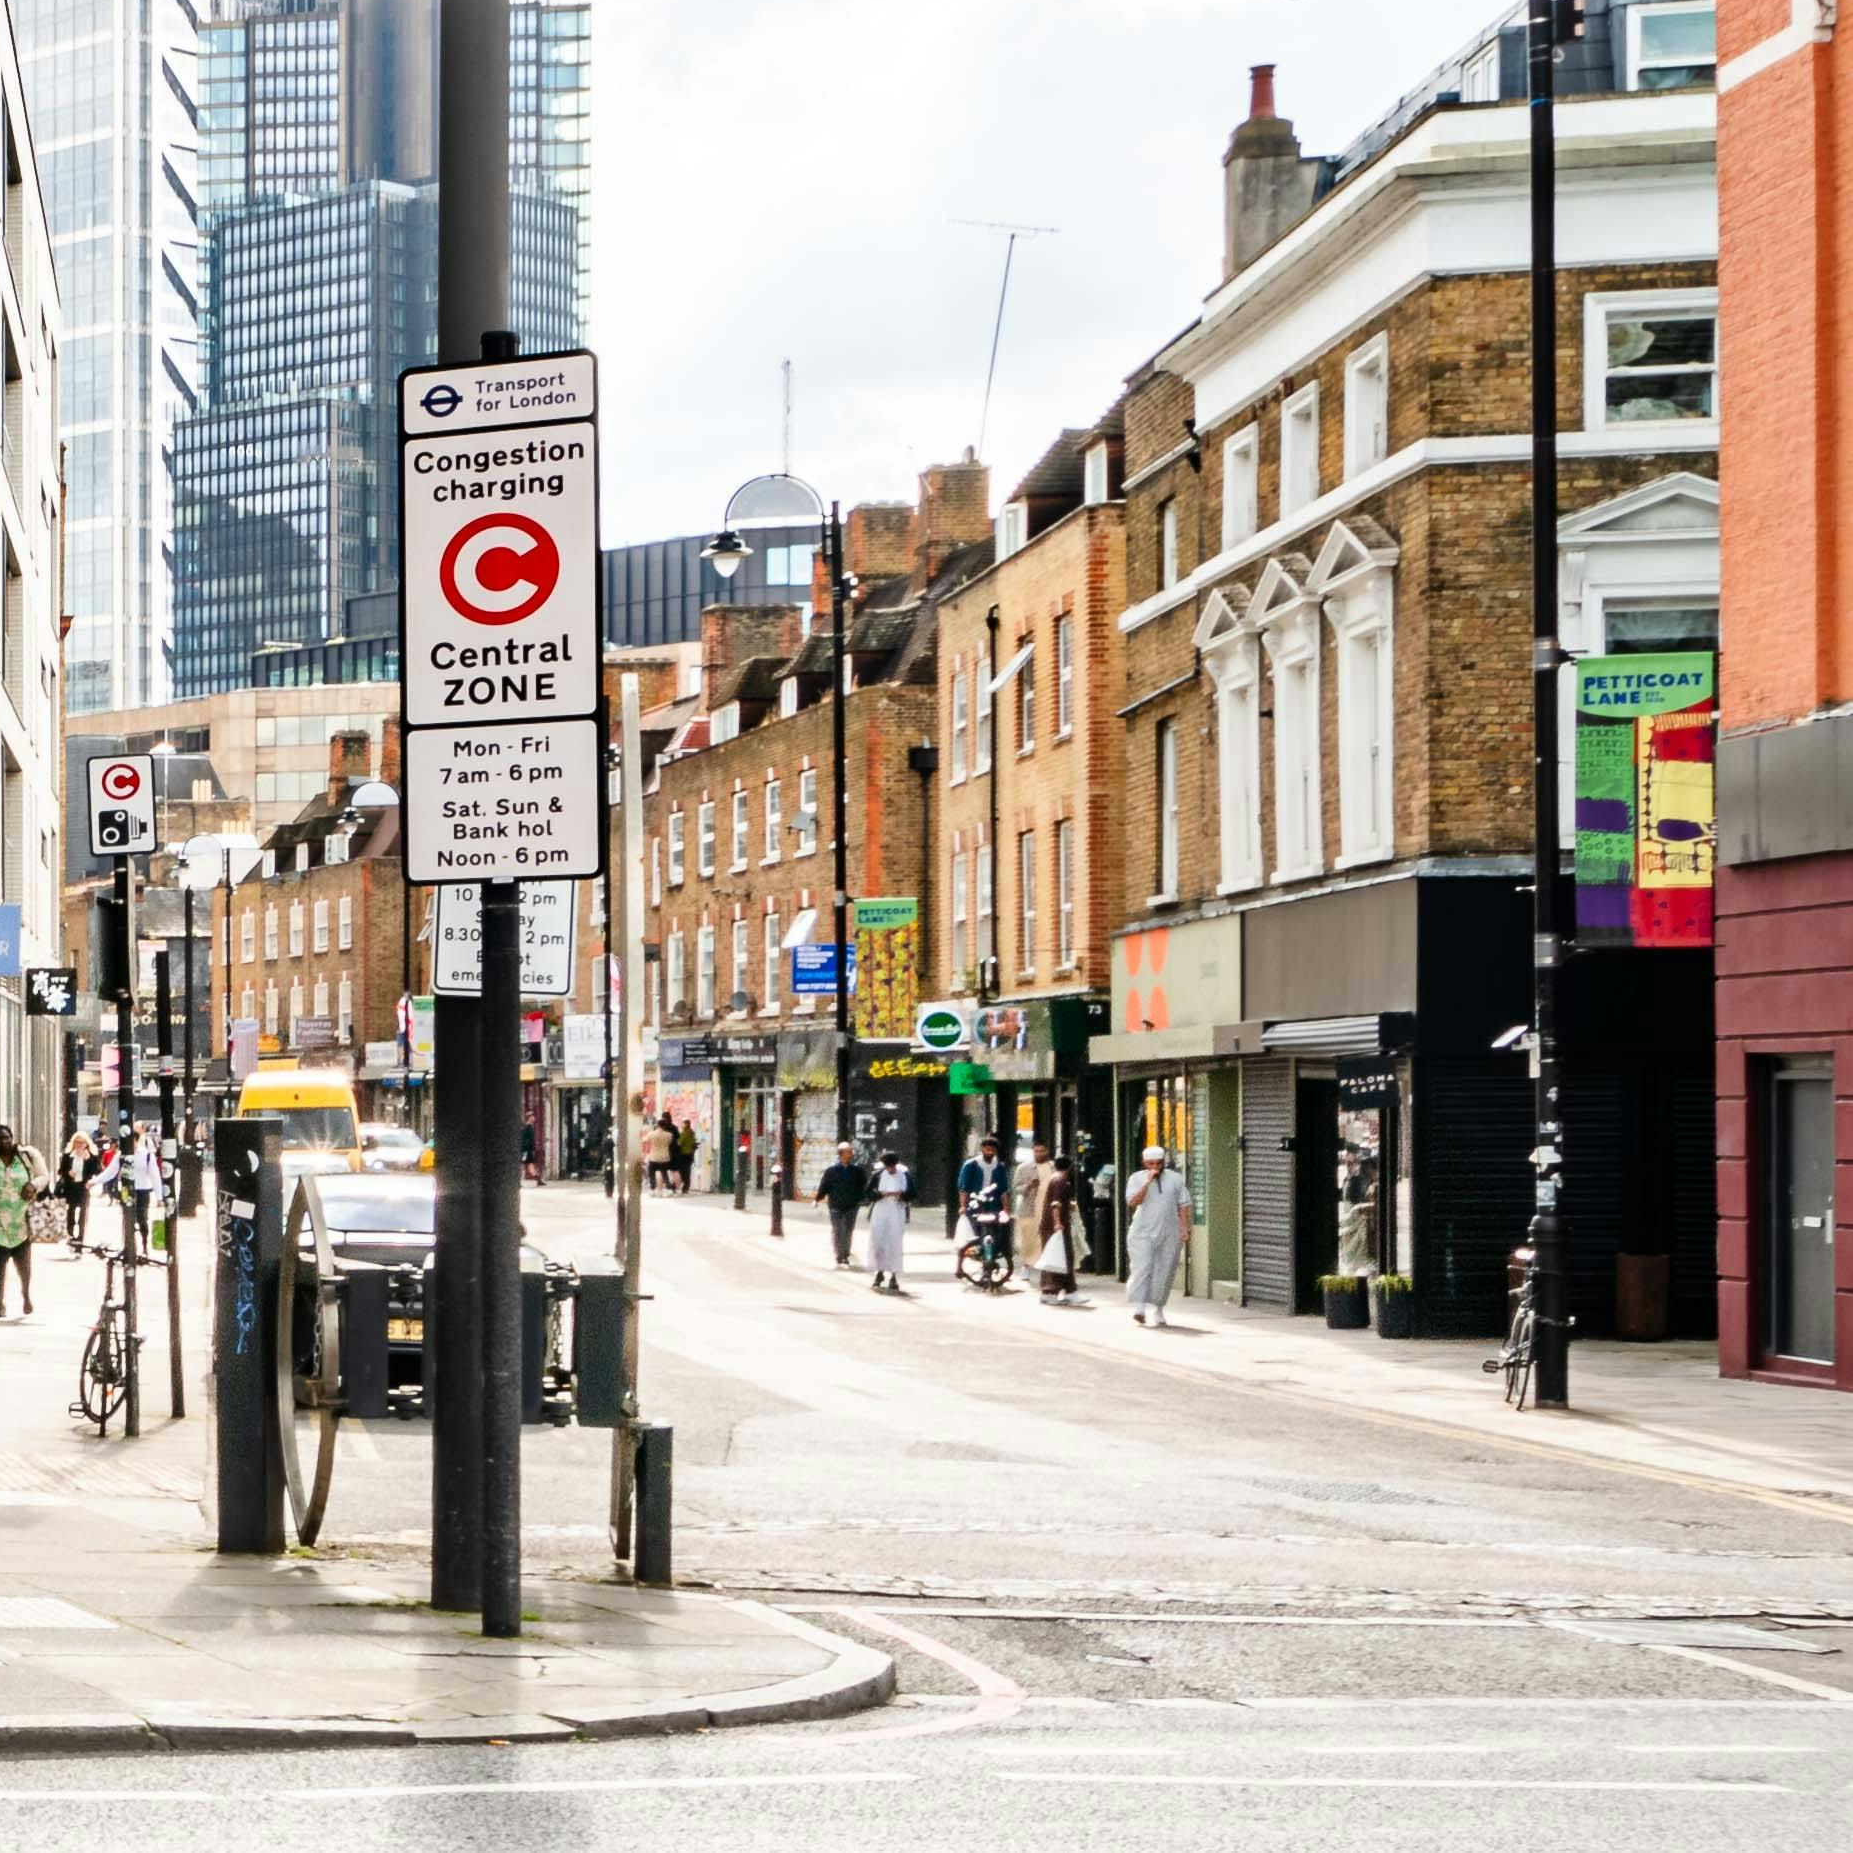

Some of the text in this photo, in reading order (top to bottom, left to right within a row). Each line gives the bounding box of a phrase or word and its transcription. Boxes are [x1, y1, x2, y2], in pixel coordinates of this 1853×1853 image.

[475, 372, 565, 394] Transport
[476, 390, 576, 412] for London
[413, 440, 585, 474] Congestion
[433, 473, 564, 503] charging
[430, 633, 572, 670] Central
[443, 672, 557, 707] ZONE
[1583, 673, 1704, 690] PETTICOAT
[1583, 691, 1641, 706] LANE
[453, 740, 501, 758] Mon
[521, 736, 550, 754] Fri
[439, 768, 452, 785] 7
[457, 769, 489, 784] am
[509, 764, 523, 781] 6
[529, 766, 563, 783] pm
[442, 796, 563, 818] Sat. Sun &
[453, 819, 553, 840] Bank hol
[437, 850, 495, 867] Noon
[515, 847, 529, 864] 6
[535, 849, 569, 866] pm
[455, 888, 473, 902] 10
[532, 893, 557, 906] pm
[858, 907, 913, 915] PETTICOAT
[858, 916, 884, 924] LANE
[444, 927, 565, 946] 8.30 2 pm
[451, 971, 554, 985] emecies
[1088, 1005, 1102, 1015] 73
[1339, 1074, 1395, 1087] PALOMA
